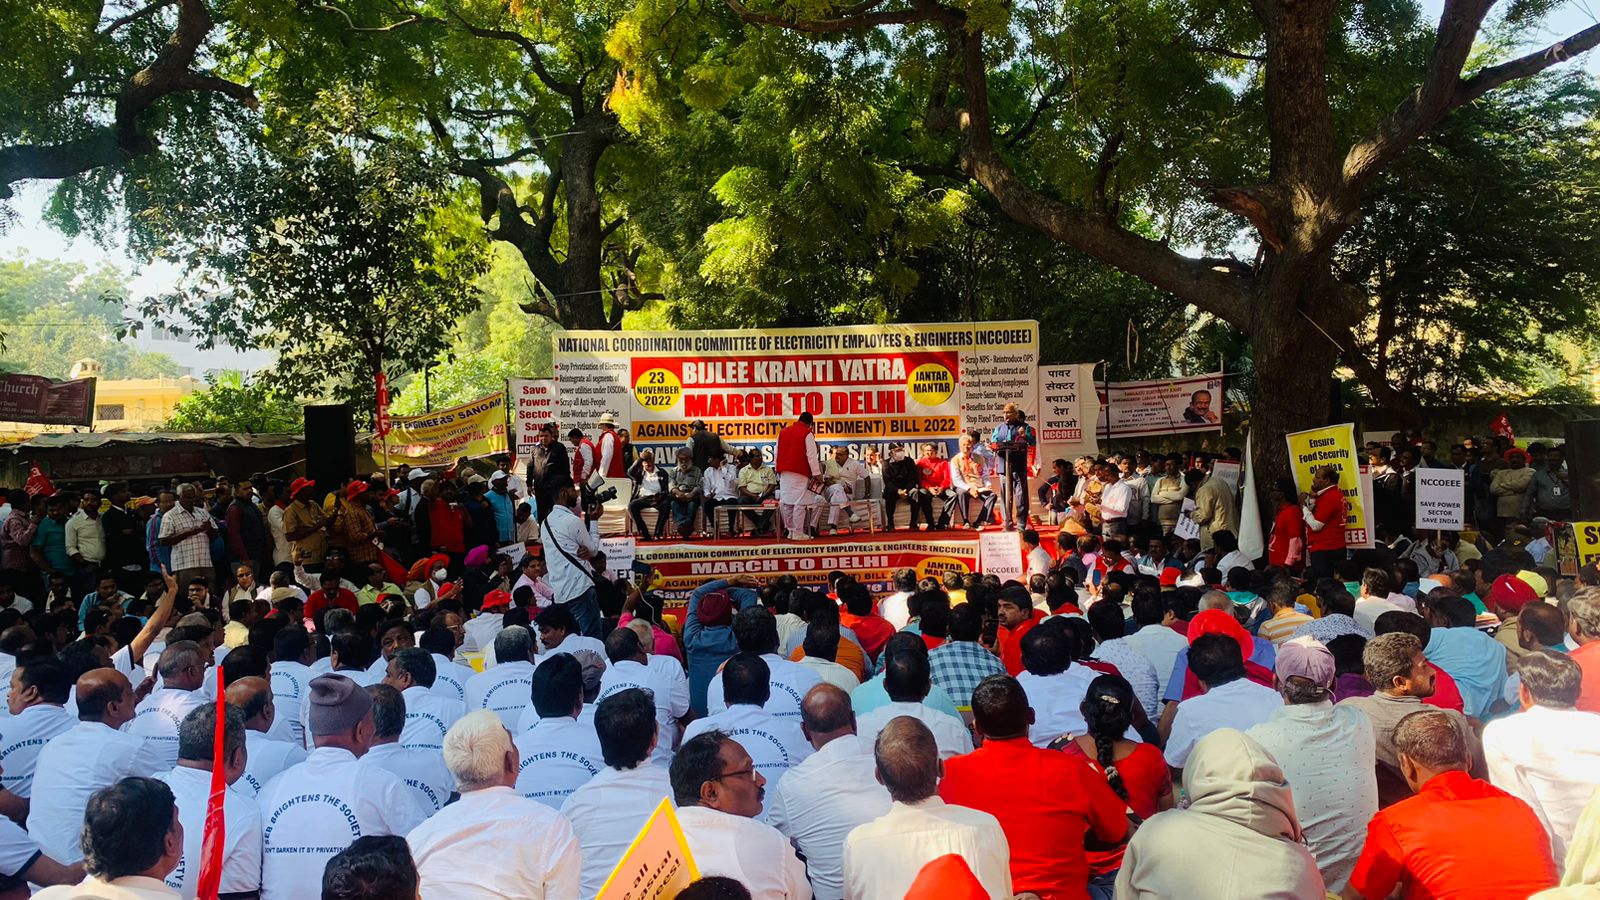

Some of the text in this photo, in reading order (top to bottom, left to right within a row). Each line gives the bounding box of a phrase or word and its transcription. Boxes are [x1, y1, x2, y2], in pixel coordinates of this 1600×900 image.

[558, 338, 609, 352] NATIONAL
[612, 337, 692, 352] COORDINATION
[695, 336, 756, 351] COMMITTEE
[760, 336, 772, 350] OF
[775, 334, 839, 350] ELECTRICITY
[842, 333, 901, 349] EMPLOYEES
[904, 334, 912, 346] &
[914, 331, 973, 347] ENGINEERS
[560, 363, 569, 372] Stop
[682, 358, 906, 384] BIJLEE KRANTI YATRA
[649, 372, 664, 383] 23
[916, 371, 948, 381] JANTAR
[523, 386, 547, 394] Save
[637, 386, 679, 394] NOVEMBER
[913, 382, 950, 394] MANTAR
[1045, 381, 1075, 390] सेक्टर
[645, 396, 671, 406] 2022
[1045, 393, 1076, 403] बचाओ
[458, 398, 501, 418] SANGAM
[684, 390, 906, 417] MARCH TO DELHI
[519, 410, 552, 419] Sector
[1053, 406, 1069, 416] देश
[637, 424, 690, 437] AGAINS
[891, 420, 920, 433] BILL
[924, 418, 956, 432] 2022
[1046, 418, 1077, 428] बचाओ
[1044, 430, 1081, 439] NCCOEEE
[1309, 438, 1335, 448] Ensure
[1299, 449, 1349, 463] Food Security
[1420, 479, 1461, 487] NCCOEEE
[646, 551, 709, 560] COORDINATION
[710, 548, 757, 559] COMMITTEE
[760, 548, 770, 556] OF
[772, 546, 824, 556] ELECTRICITY
[826, 545, 873, 553] EMPLOYEES
[883, 544, 928, 552] ENGINEERS
[692, 556, 889, 574] MARCH TO DELHI
[928, 562, 962, 571] JANTAR
[665, 579, 702, 588] AGAINS
[421, 712, 435, 720] THE
[752, 729, 788, 761] THE SOCIETY
[561, 751, 578, 760] THE
[419, 782, 440, 810] SOCIETY
[270, 794, 320, 824] BRIGHTENS
[323, 794, 341, 807] THE
[340, 803, 361, 836] SOCIET
[633, 863, 648, 888] all
